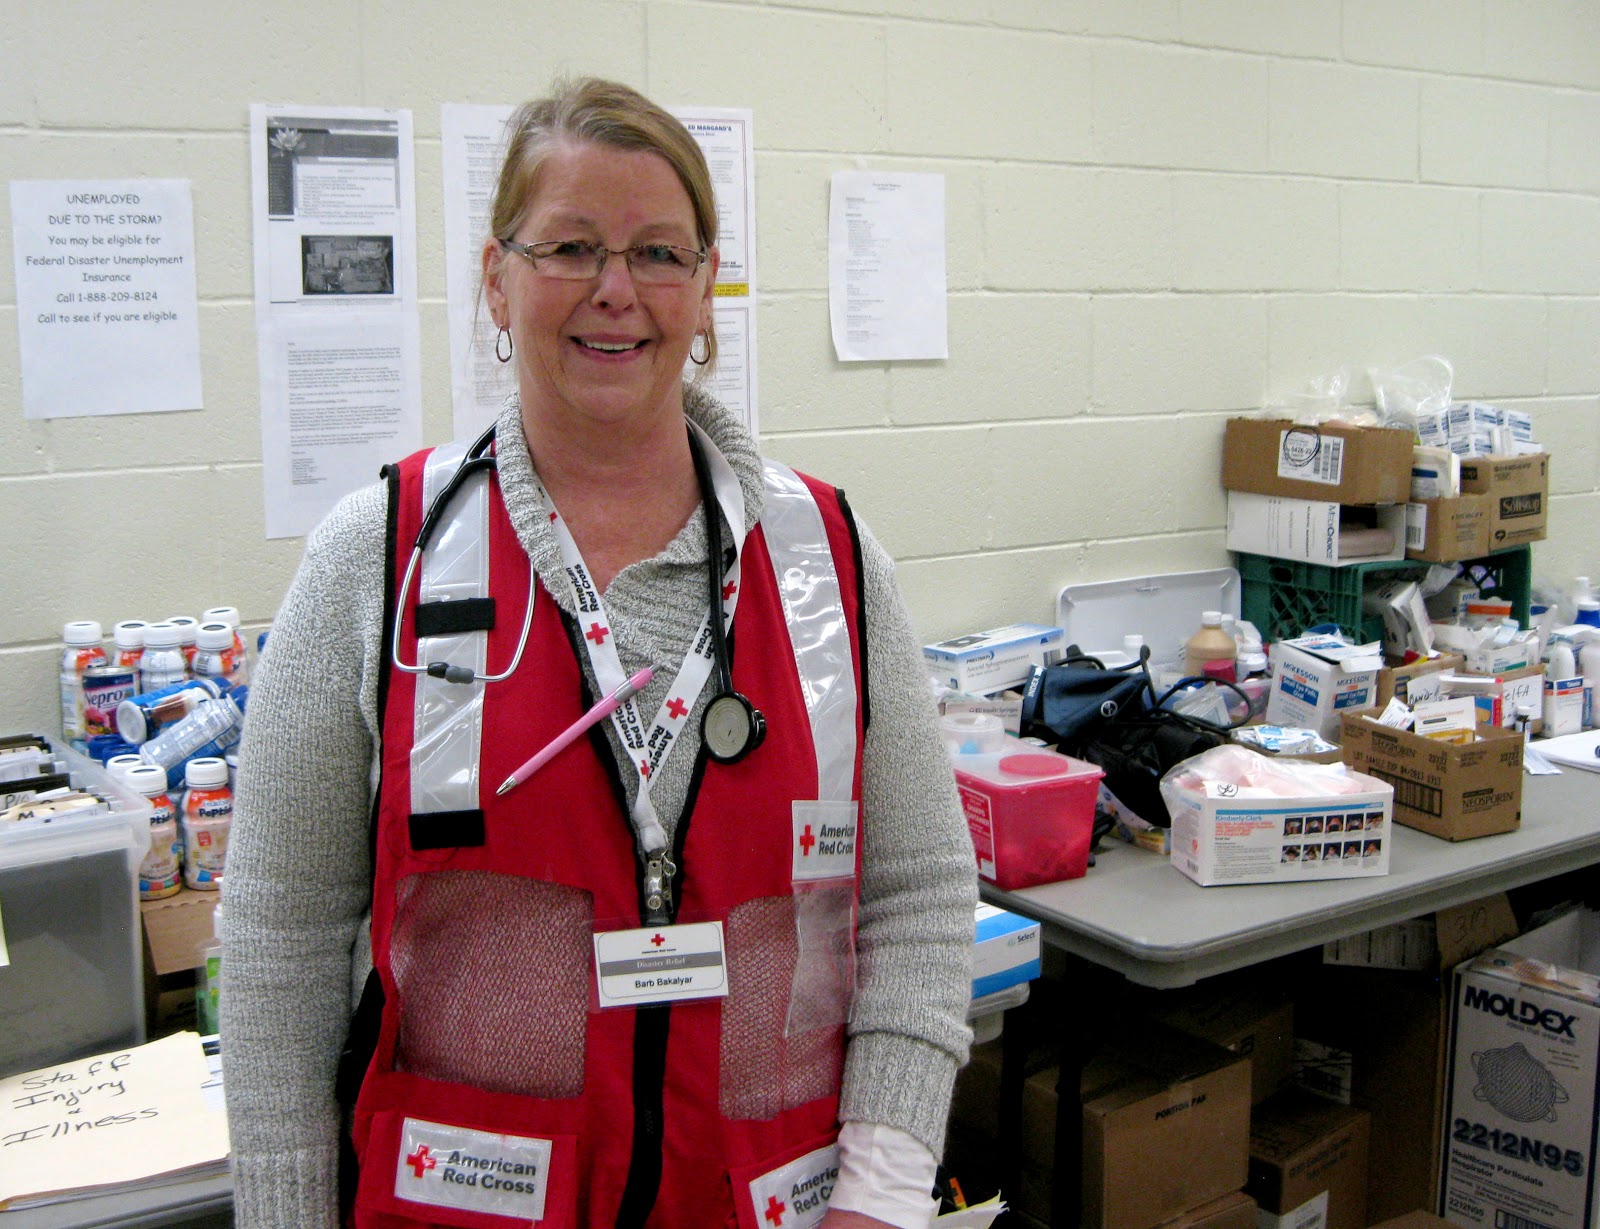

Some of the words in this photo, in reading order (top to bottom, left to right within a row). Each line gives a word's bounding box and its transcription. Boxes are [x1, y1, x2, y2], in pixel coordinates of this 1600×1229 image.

[67, 194, 140, 204] UNEMPLOYED
[49, 214, 71, 225] DUE
[75, 214, 90, 224] TO
[94, 214, 115, 224] THE
[118, 214, 162, 224] STORM?
[48, 236, 66, 246] You
[70, 237, 89, 248] may
[92, 235, 104, 244] be
[107, 235, 142, 247] eligible
[146, 235, 162, 244] for
[26, 256, 65, 266] Federal
[68, 256, 110, 266] Disaster
[114, 256, 184, 267] Unemployment
[82, 272, 132, 282] Insurance
[56, 292, 75, 303] Call
[78, 291, 158, 302] 1-888-209-8124
[38, 314, 56, 324] Call
[58, 314, 70, 323] to
[73, 315, 90, 323] see
[93, 312, 101, 323] if
[104, 314, 122, 325] you
[124, 314, 140, 322] are
[143, 312, 178, 324] eligible
[574, 564, 591, 589] Cross
[566, 567, 590, 612] American
[586, 590, 600, 612] Red
[695, 628, 712, 654] Cross
[624, 699, 637, 724] Cro
[616, 706, 636, 750] Americ
[630, 726, 645, 749] Red
[648, 725, 666, 749] Red
[649, 730, 674, 779] Americ
[199, 804, 232, 818] Peptid
[820, 824, 856, 838] Americ
[819, 841, 836, 855] Red
[1017, 932, 1036, 942] Select
[635, 980, 654, 988] Barb
[656, 976, 693, 986] Bakalyar
[1463, 985, 1576, 1038] MOLDEX
[22, 1054, 132, 1090] Staff
[12, 1078, 126, 1109] Injury
[2, 1106, 160, 1147] Illness
[1453, 1118, 1584, 1177] 2212N95
[447, 1150, 536, 1176] American
[1452, 1156, 1493, 1178] Respirator
[1452, 1148, 1496, 1170] Healthcare
[1498, 1165, 1544, 1187] Particulate
[443, 1167, 478, 1186] Red
[481, 1174, 535, 1194] Cross
[792, 1168, 840, 1198] Americ
[794, 1191, 820, 1214] Red
